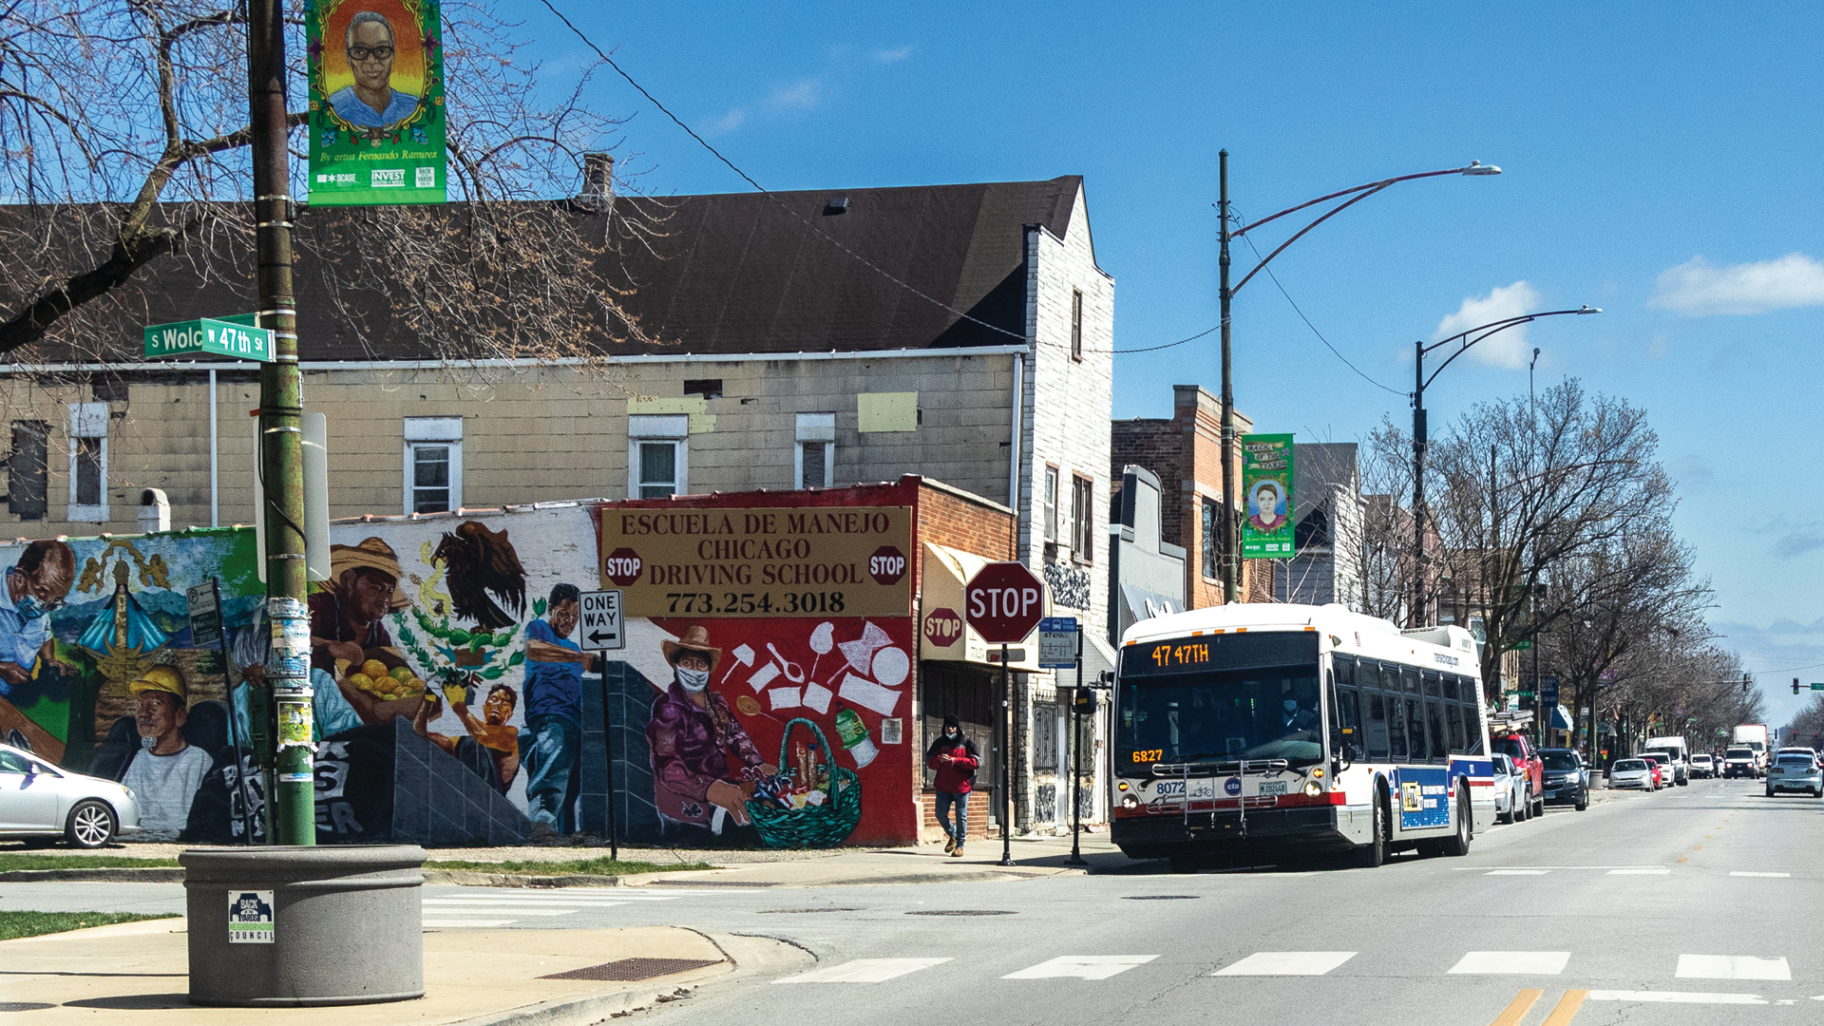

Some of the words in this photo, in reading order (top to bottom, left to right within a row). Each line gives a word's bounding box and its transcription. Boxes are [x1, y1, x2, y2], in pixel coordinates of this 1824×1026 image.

[320, 152, 331, 162] By
[334, 152, 355, 161] artist
[358, 150, 399, 161] Fernando
[402, 149, 438, 159] Ramirez
[372, 172, 406, 181] INVEST
[151, 334, 159, 348] S
[163, 327, 202, 350] Wolc
[208, 328, 215, 343] W
[219, 327, 250, 354] 47th
[254, 337, 263, 351] St
[621, 513, 736, 535] ESCUELA
[743, 513, 776, 534] DE
[787, 511, 890, 534] MANEJO
[697, 538, 811, 561] CHICAGO
[607, 557, 641, 577] STOP
[649, 563, 751, 586] DRIVING
[762, 562, 864, 585] SCHOOL
[870, 555, 905, 576] STOP
[583, 595, 615, 610] ONE
[666, 591, 845, 614] 773.254.3018
[969, 587, 1038, 618] STOP
[583, 611, 617, 627] WAY
[926, 617, 961, 638] STOP
[1152, 645, 1171, 666] 47
[1174, 643, 1209, 664] 47TH
[1132, 749, 1162, 763] 6827
[1157, 782, 1185, 794] 8072
[240, 899, 258, 909] BACK
[229, 931, 274, 940] COUNCIL
